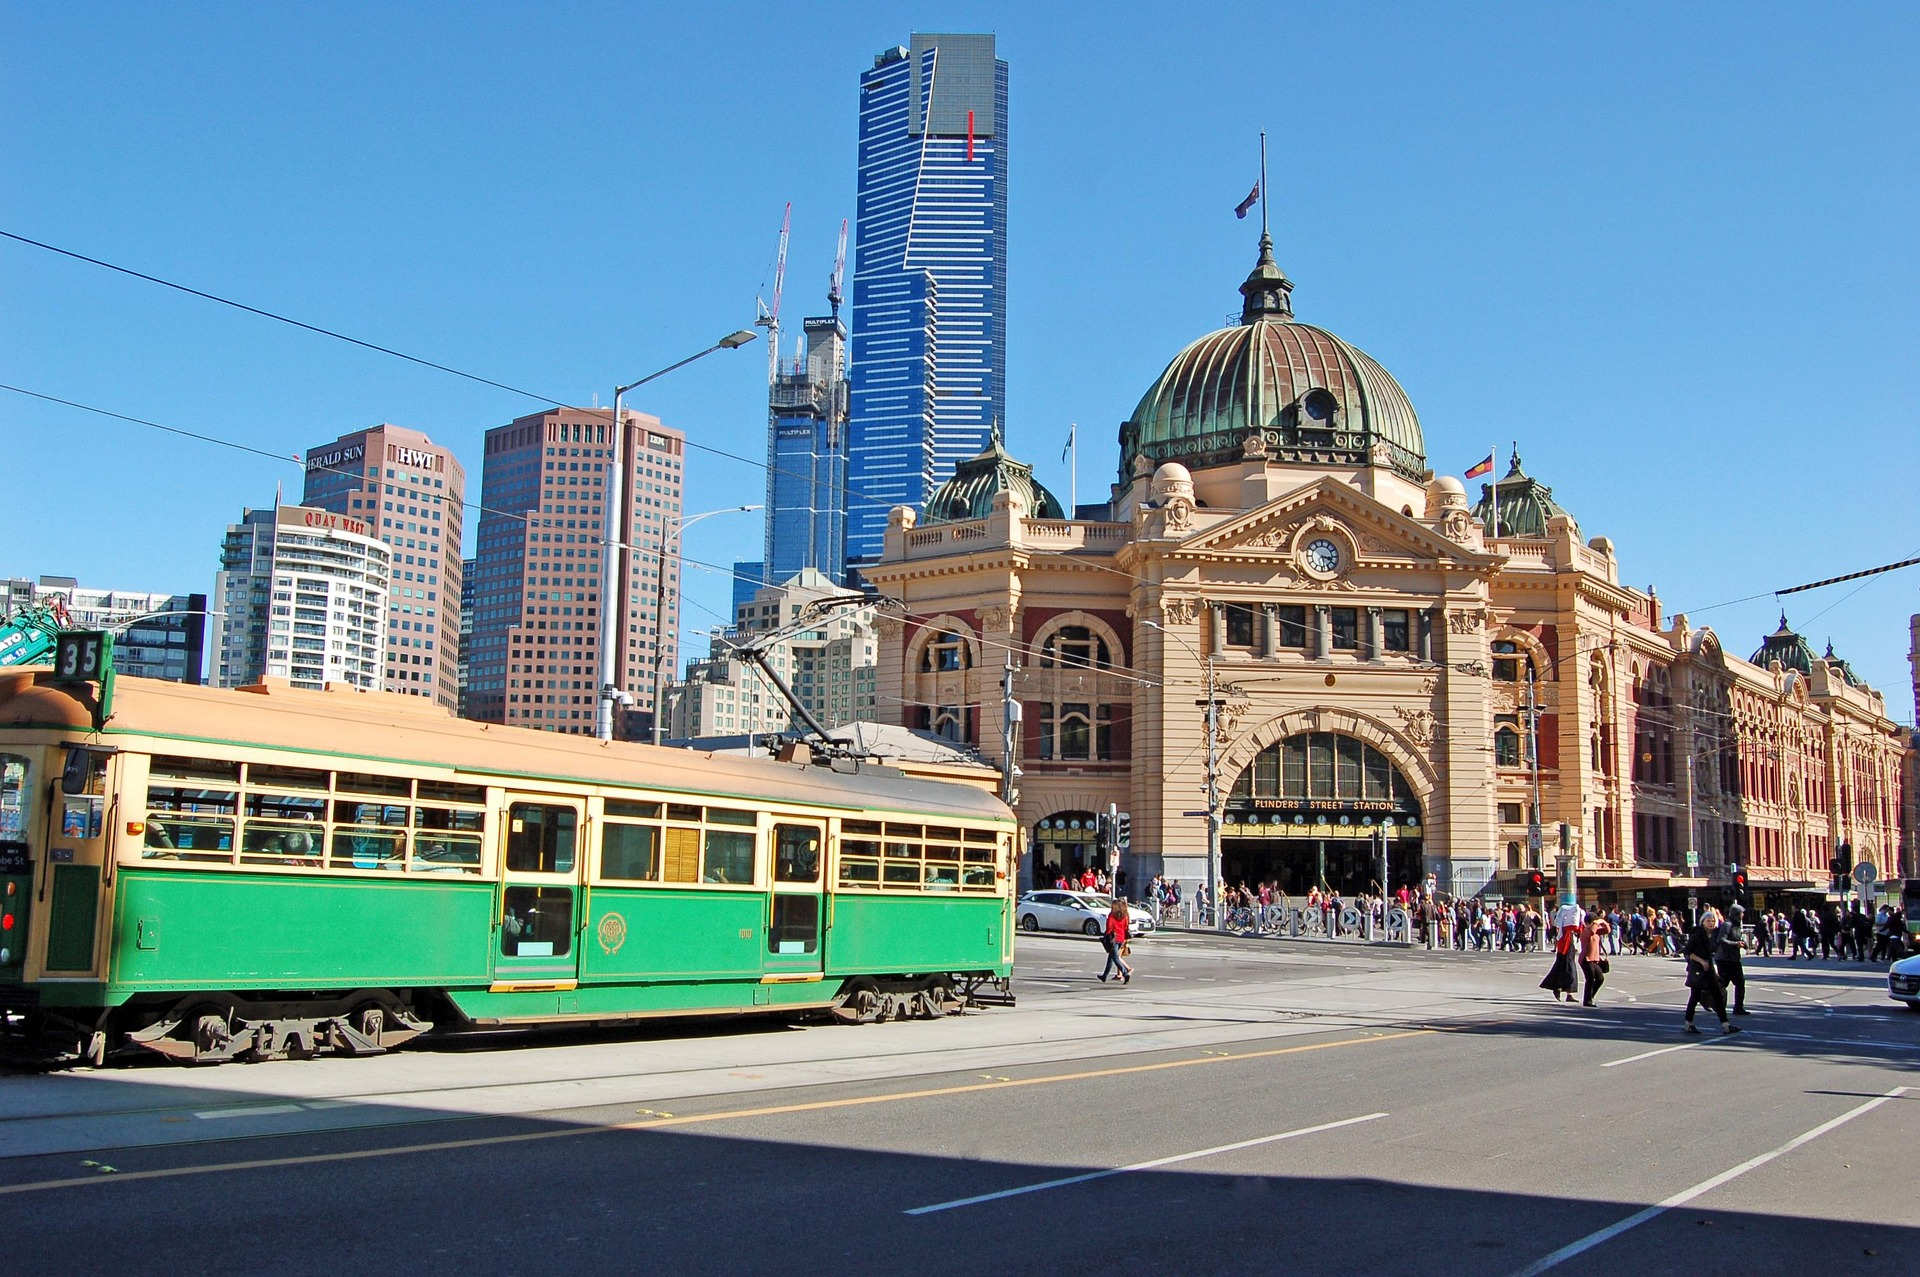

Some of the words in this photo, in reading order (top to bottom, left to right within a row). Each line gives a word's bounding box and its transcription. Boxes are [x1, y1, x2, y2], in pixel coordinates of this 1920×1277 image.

[344, 445, 364, 459] SUN
[399, 446, 435, 468] HWT
[305, 512, 336, 528] QUAY
[343, 518, 365, 534] WEST
[63, 641, 97, 675] 35
[1254, 800, 1300, 808] FLINDERS
[1310, 801, 1344, 810] STREET
[1353, 802, 1394, 810] STATION
